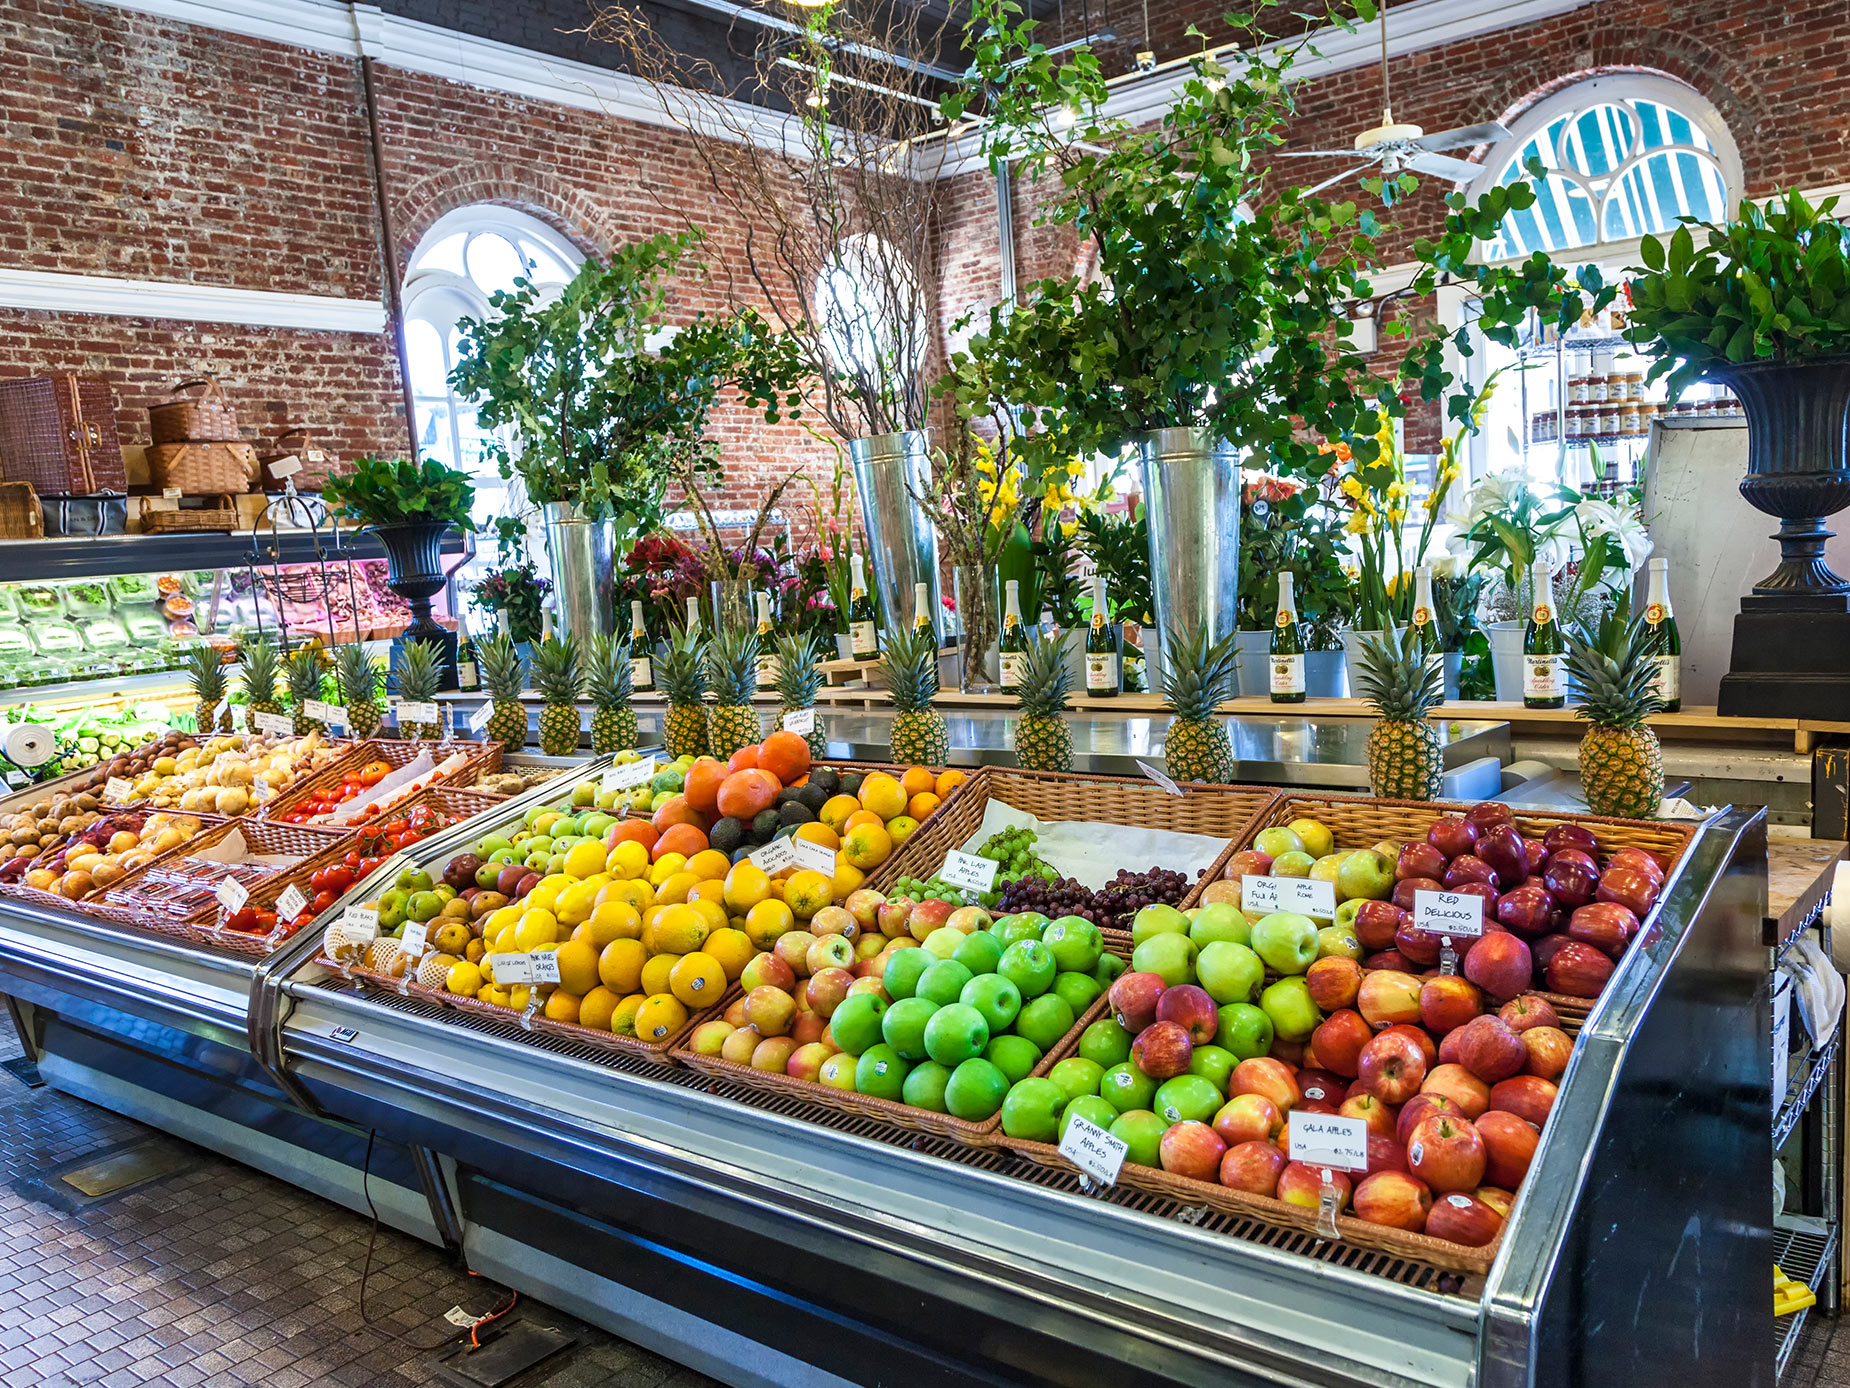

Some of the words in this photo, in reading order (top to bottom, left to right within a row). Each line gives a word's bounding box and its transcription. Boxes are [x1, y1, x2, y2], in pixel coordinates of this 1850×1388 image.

[1527, 657, 1557, 665] Martinelli's
[1438, 893, 1459, 905] RED
[1425, 906, 1472, 920] DELICIOUS
[1073, 1118, 1103, 1140] GRANNY
[1104, 1135, 1125, 1153] SMITH
[1303, 1123, 1324, 1133] GALA
[1327, 1126, 1352, 1136] APPLES
[1065, 1145, 1077, 1156] USA
[1080, 1137, 1107, 1158] APPLES
[1294, 1142, 1307, 1150] USA
